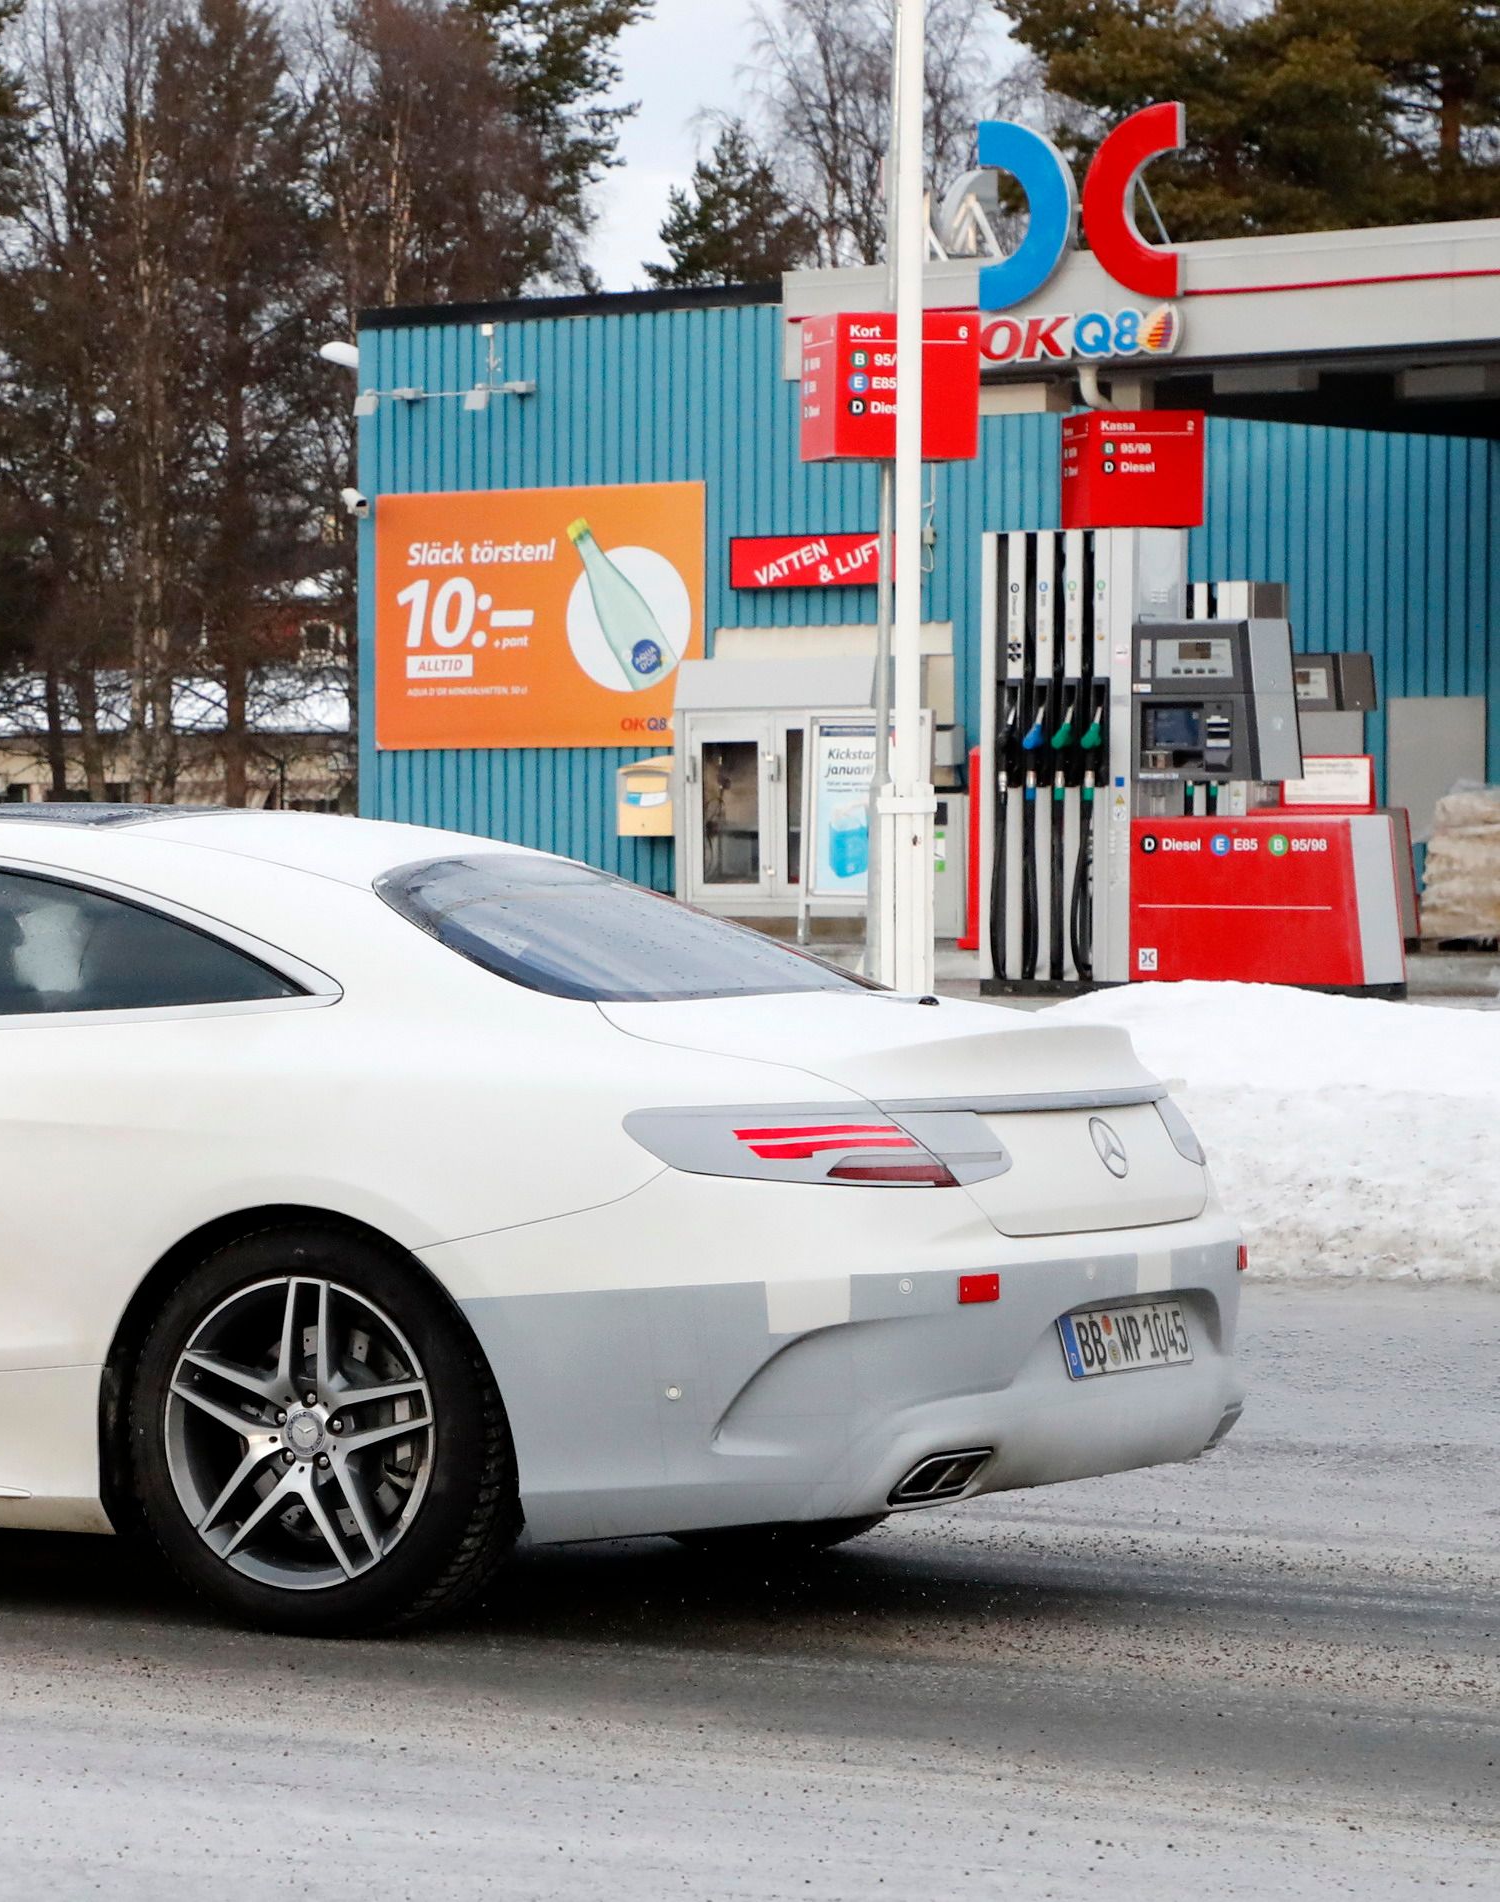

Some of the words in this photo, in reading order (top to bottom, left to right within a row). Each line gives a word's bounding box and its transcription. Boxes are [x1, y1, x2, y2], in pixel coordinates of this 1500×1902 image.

[849, 324, 882, 338] Kort
[958, 325, 969, 338] 6
[854, 352, 866, 366] B
[853, 376, 864, 389] E
[851, 401, 864, 414] D
[1100, 420, 1136, 431] Kassa
[1120, 442, 1152, 454] 95/98
[1104, 461, 1114, 473] D
[1120, 460, 1156, 473] Diesel
[407, 540, 465, 566] Släck
[470, 537, 557, 565] törsten!
[754, 538, 830, 586] VATTEN
[818, 564, 835, 583] &
[501, 635, 529, 649] pant
[417, 659, 464, 672] ALLTID
[828, 748, 876, 760] Kickstar
[1143, 838, 1156, 851] D
[1161, 837, 1202, 851] Diesel
[1215, 838, 1226, 851] E
[1233, 838, 1259, 851] E85
[1273, 838, 1283, 851] B
[1291, 838, 1328, 852] 95/98
[1076, 1320, 1107, 1368] BB
[1114, 1315, 1142, 1362] WP
[1143, 1310, 1189, 1359] 1045
